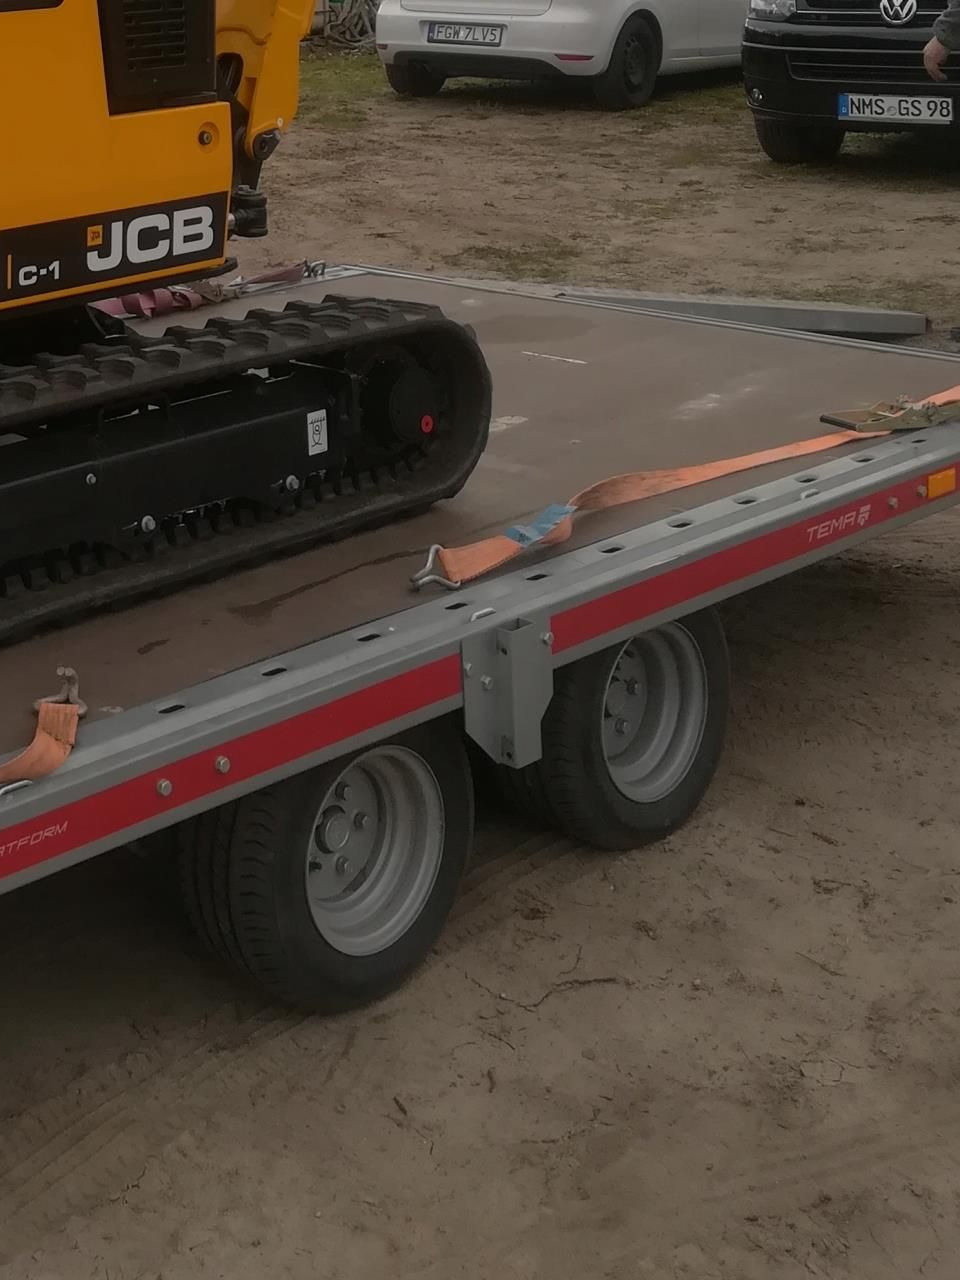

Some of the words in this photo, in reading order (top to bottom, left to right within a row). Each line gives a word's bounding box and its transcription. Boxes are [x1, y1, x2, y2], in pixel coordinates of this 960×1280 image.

[850, 97, 886, 116] NMS
[898, 99, 922, 117] GS
[926, 100, 951, 118] 98
[86, 205, 214, 272] JCB
